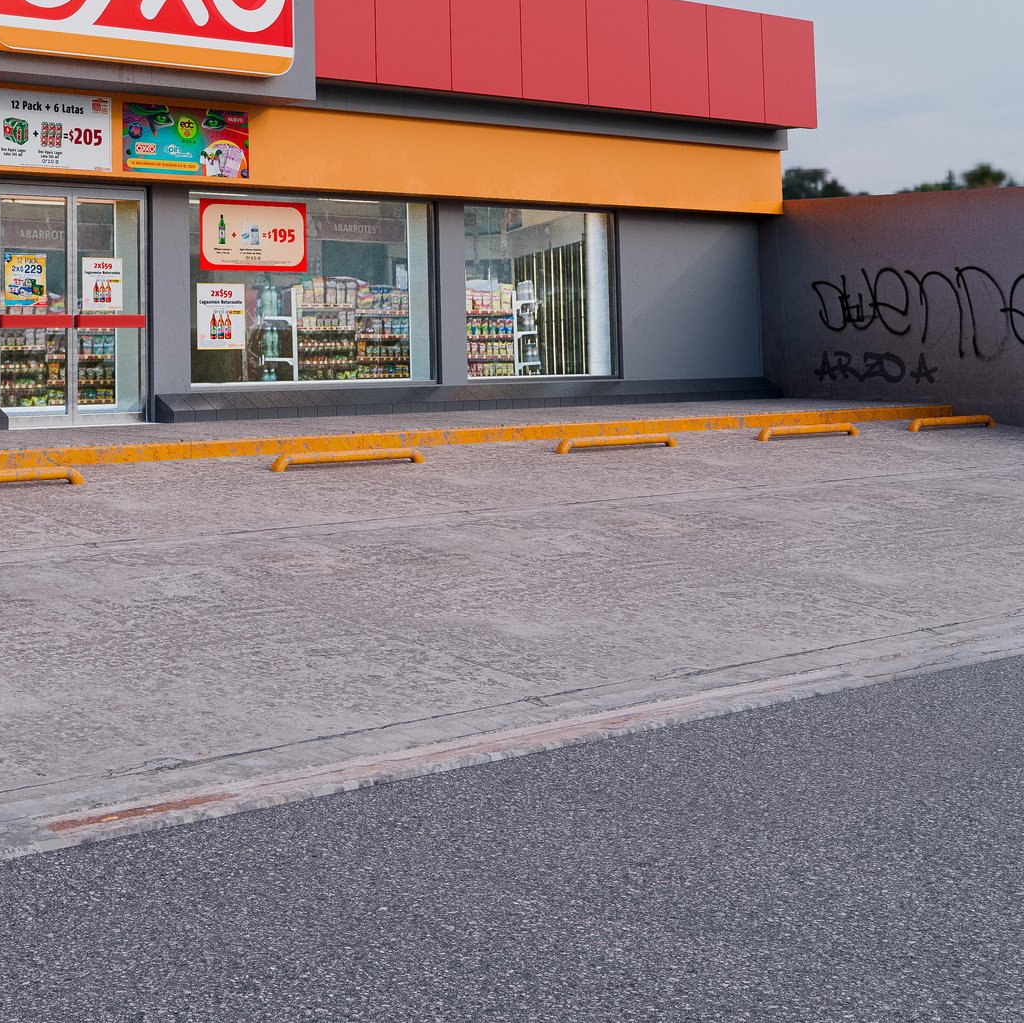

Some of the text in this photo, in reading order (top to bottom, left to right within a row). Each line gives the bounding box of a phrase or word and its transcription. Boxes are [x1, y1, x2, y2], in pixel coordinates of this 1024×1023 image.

[10, 100, 20, 110] 12
[22, 101, 42, 111] Pack
[53, 103, 59, 112] 6
[62, 103, 84, 114] Latas
[179, 120, 195, 129] edc
[136, 144, 156, 153] OXXO
[24, 256, 39, 264] Pack
[93, 262, 113, 270] 2x$59
[210, 288, 233, 298] 2x$59
